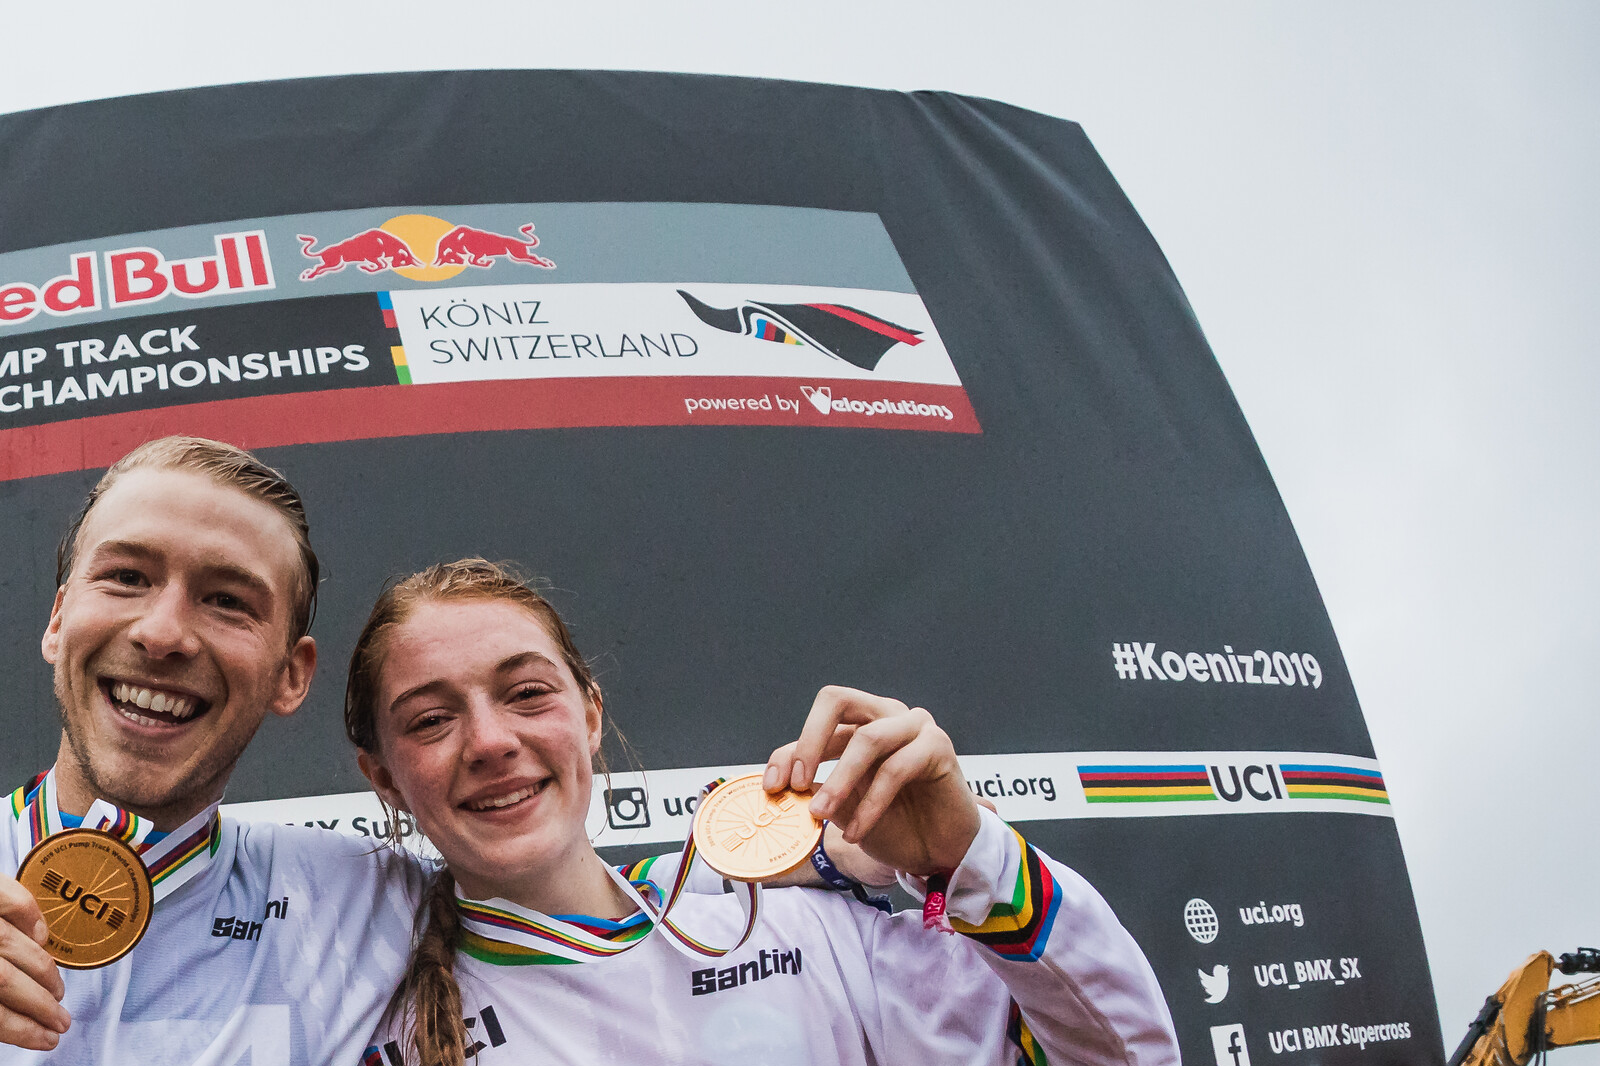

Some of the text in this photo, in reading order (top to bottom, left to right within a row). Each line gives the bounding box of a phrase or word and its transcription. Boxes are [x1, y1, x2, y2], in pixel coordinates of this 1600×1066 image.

[105, 230, 276, 309] Bull
[420, 299, 550, 330] KÖNIZ
[56, 325, 200, 369] TRACK
[430, 333, 700, 365] SWITZERLAND
[684, 386, 954, 420] powered by Velosolutions
[1112, 642, 1323, 689] #Koeniz2019
[1210, 763, 1283, 802] UCI
[59, 878, 110, 920] UCI
[1239, 901, 1305, 927] uci.org
[1254, 957, 1362, 990] UCI_BMX_SX
[1268, 1021, 1411, 1055] UCI BMX Supercross
